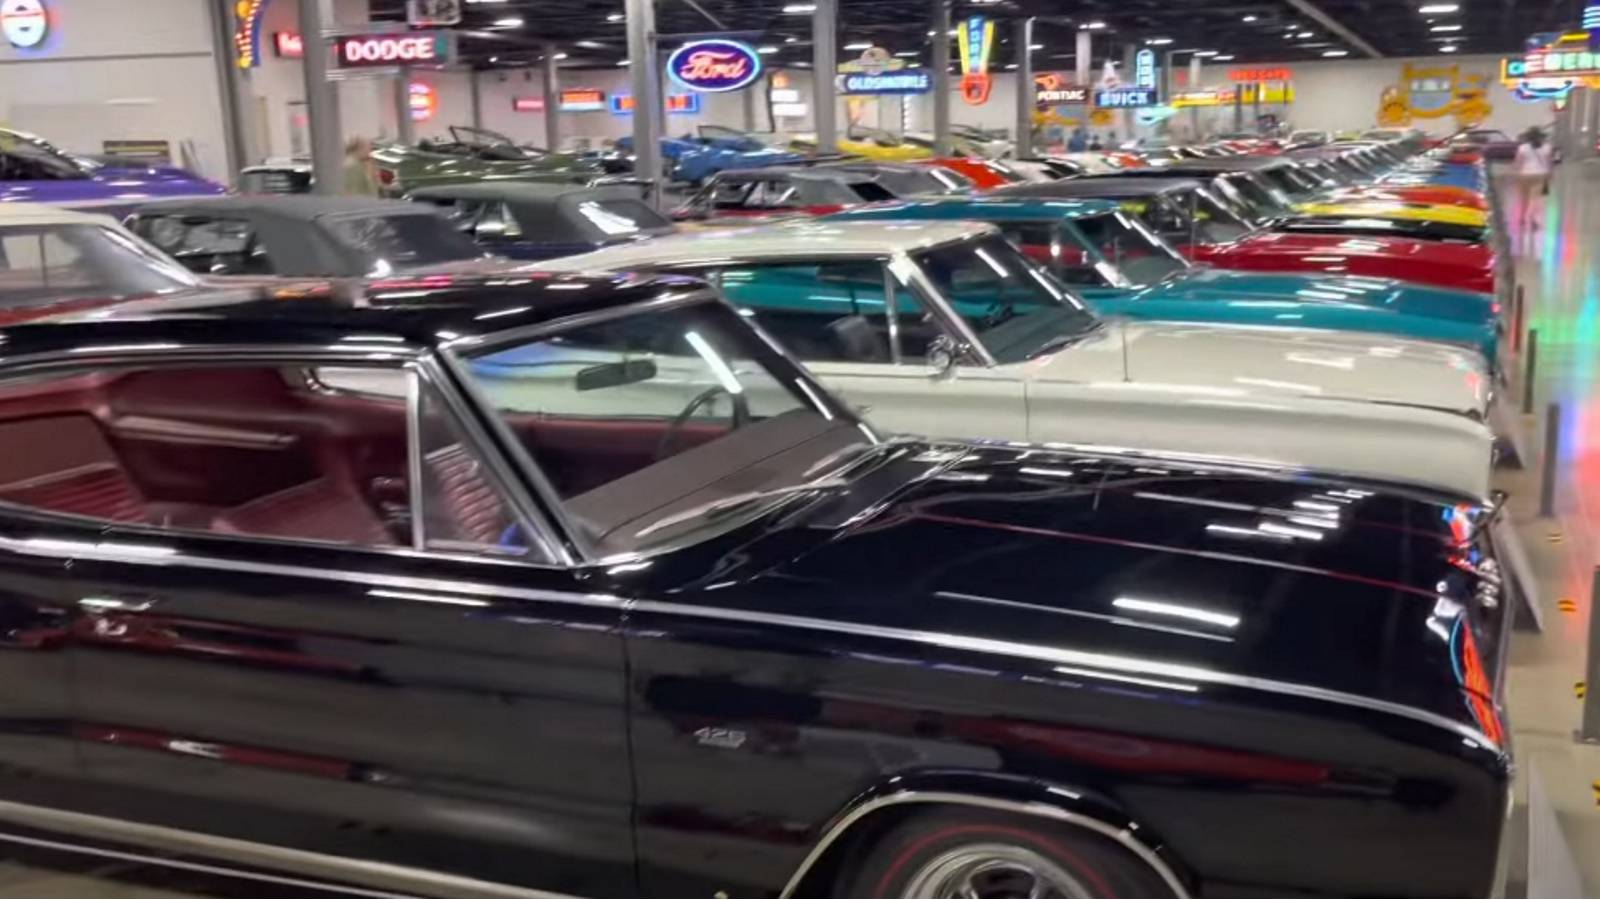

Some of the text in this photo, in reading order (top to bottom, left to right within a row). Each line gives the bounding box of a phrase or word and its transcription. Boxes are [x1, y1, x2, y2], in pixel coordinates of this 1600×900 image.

[345, 37, 434, 61] DODGE
[680, 50, 748, 80] Ford
[1100, 92, 1148, 106] BUICK
